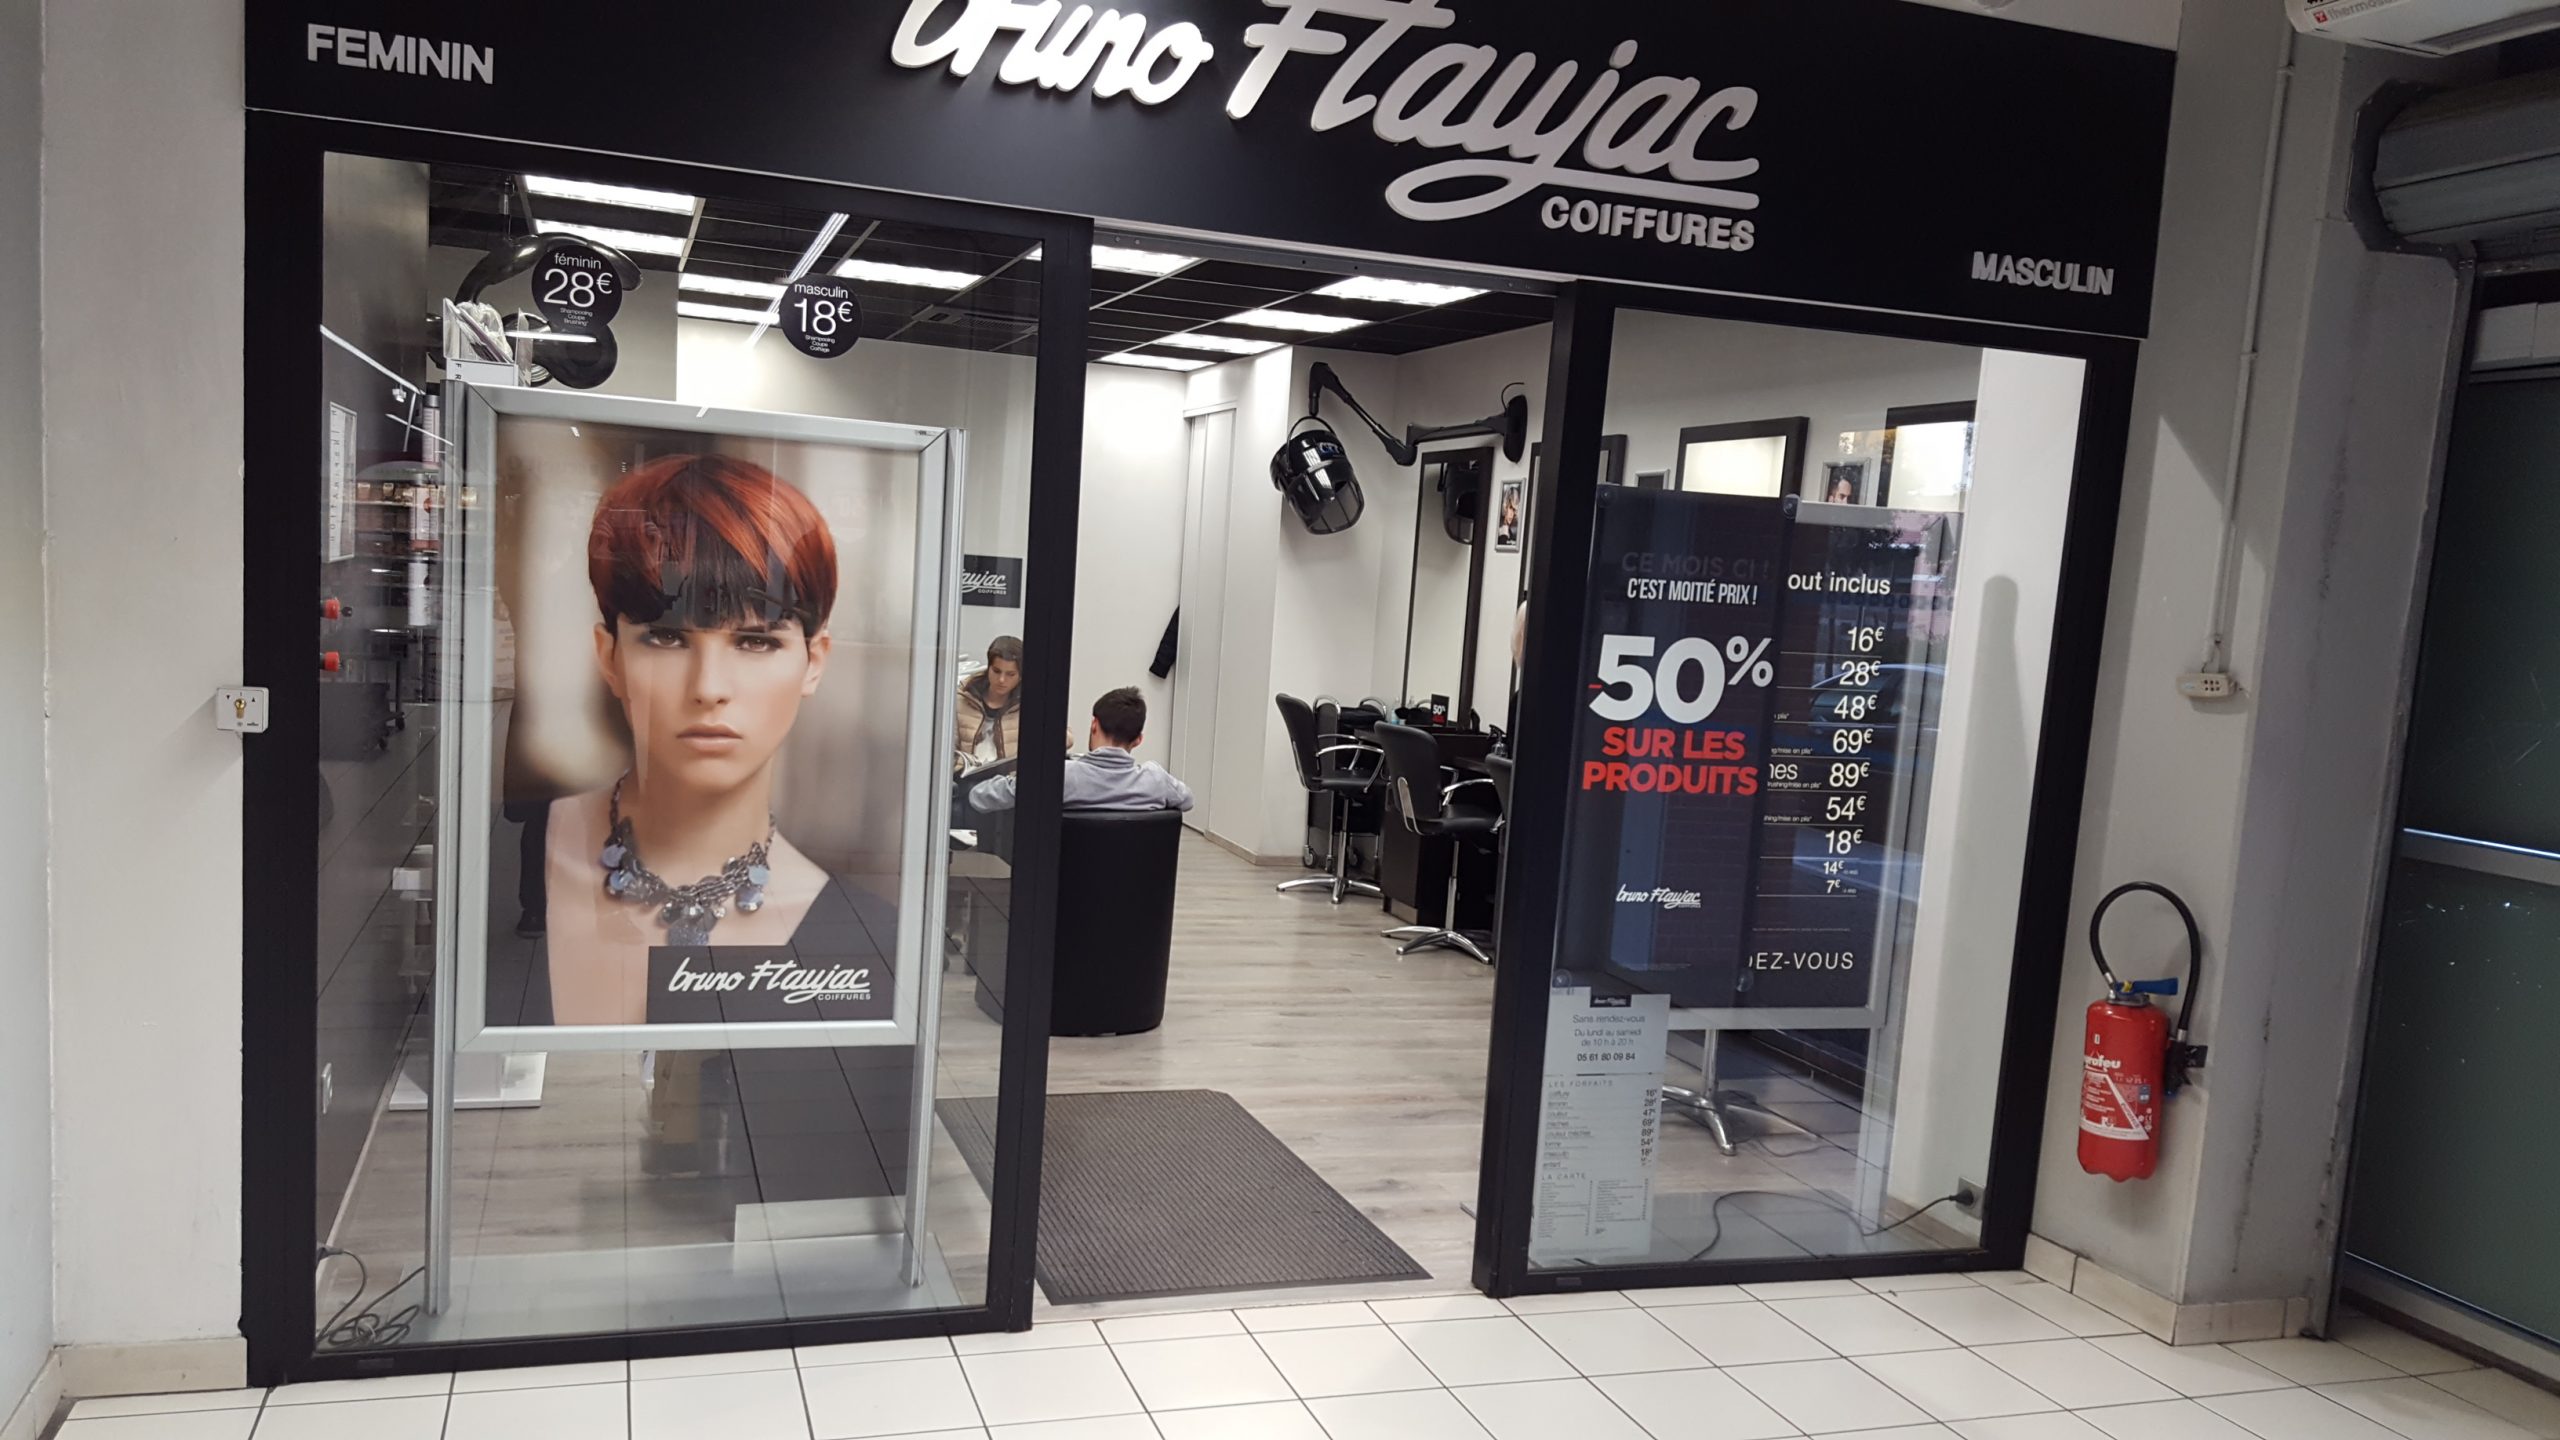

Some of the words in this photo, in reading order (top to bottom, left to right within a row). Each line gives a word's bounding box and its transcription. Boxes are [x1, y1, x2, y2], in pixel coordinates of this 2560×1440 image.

[308, 23, 494, 85] FEMININ
[1541, 196, 1755, 252] COIFFURES
[554, 253, 602, 269] féminin
[1971, 251, 2114, 295] MASCULIN
[543, 268, 613, 308] 28€
[794, 283, 849, 299] masculin
[567, 313, 586, 321] Coupe
[793, 298, 853, 336] 18€
[1627, 577, 1667, 600] C'EST
[1668, 578, 1716, 603] MOITIÉ
[1717, 583, 1750, 605] PRIX
[1787, 571, 1822, 592] out
[1829, 571, 1891, 595] inclus
[1847, 626, 1885, 652] 16€
[1839, 660, 1881, 686] 28€
[1834, 694, 1877, 720] 48€
[1602, 726, 1675, 759] SUR
[1683, 730, 1745, 761] LES
[1833, 728, 1874, 754] 69€
[1582, 761, 1758, 796] PRODUITS
[1829, 762, 1870, 788] 89€
[1826, 796, 1867, 821] 54€
[1825, 829, 1863, 854] 18€
[1823, 860, 1845, 875] 14€
[1616, 883, 1649, 902] bruno
[1826, 879, 1841, 894] 7€
[1749, 952, 1854, 970] EZ-VOUS
[668, 957, 745, 992] bruno
[817, 993, 872, 1001] COIFFURES
[1572, 1014, 1594, 1024] Sans
[1577, 1053, 1587, 1062] 05
